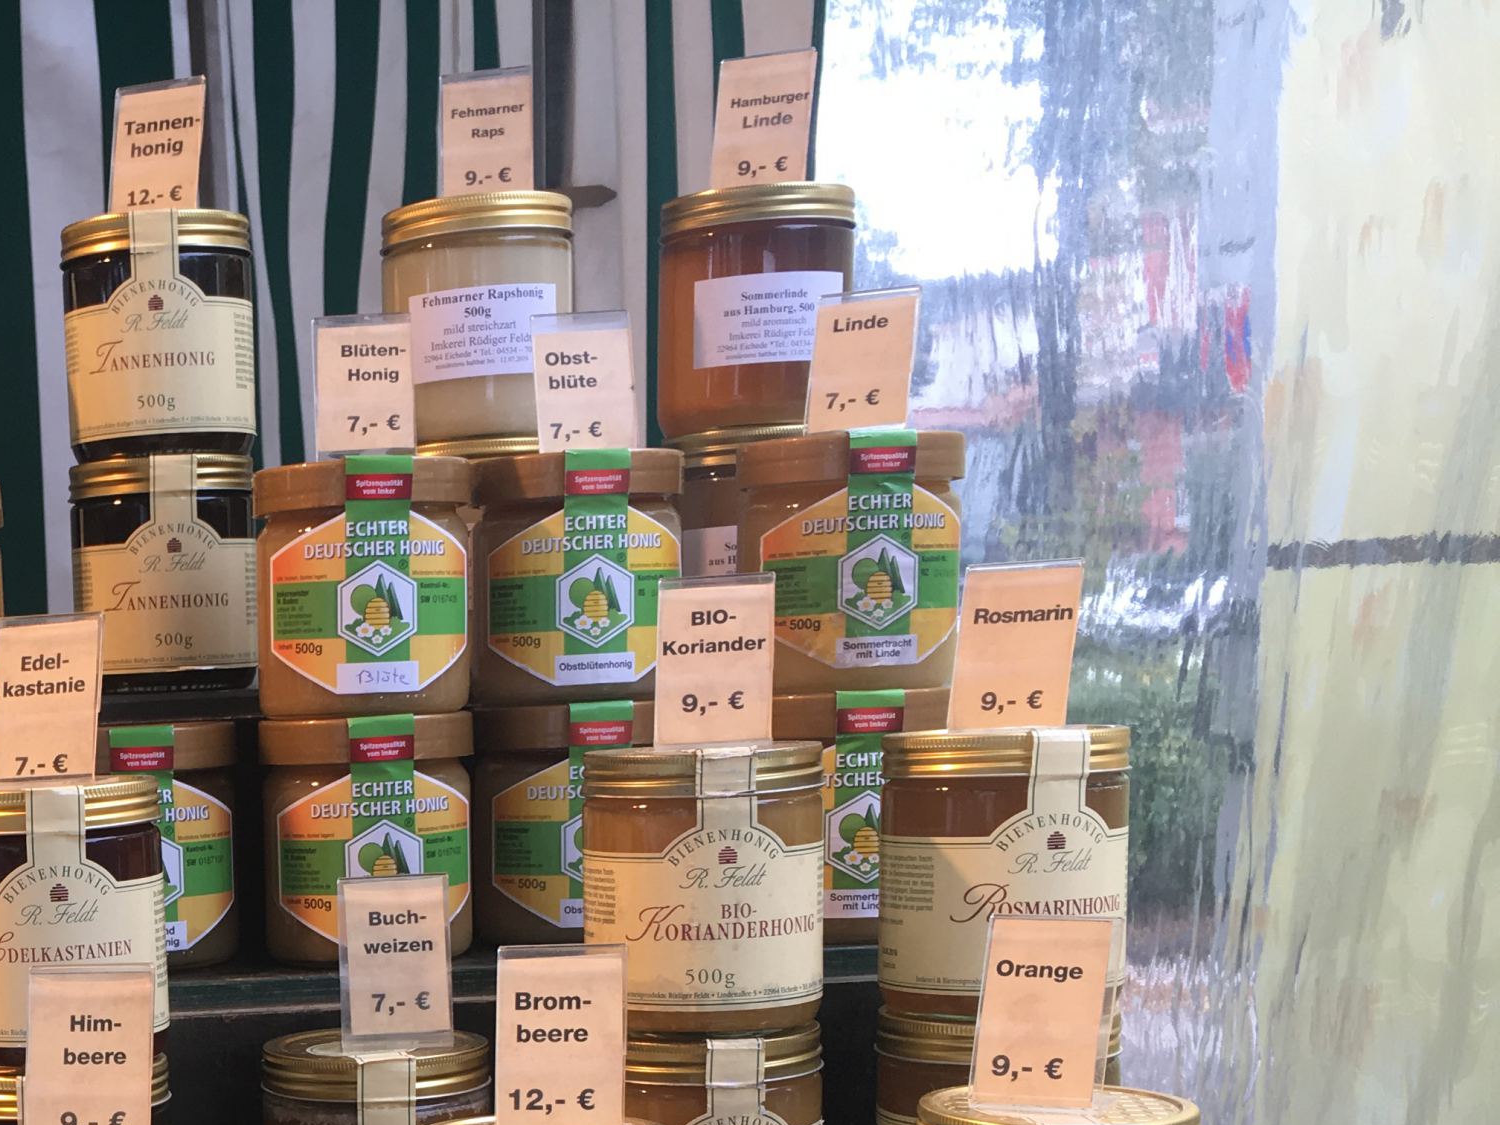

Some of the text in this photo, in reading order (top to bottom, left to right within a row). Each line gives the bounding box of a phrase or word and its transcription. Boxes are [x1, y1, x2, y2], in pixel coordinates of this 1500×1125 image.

[730, 91, 810, 109] Hamburger
[451, 101, 524, 120] Fehmarner
[124, 115, 200, 136] Tannen-
[742, 112, 793, 129] Linde
[471, 125, 505, 140] Raps
[130, 139, 184, 159] honig
[465, 167, 512, 186] 9.- €
[737, 156, 788, 178] 9,- €
[127, 185, 182, 207] 12.- €
[422, 286, 544, 309] Fehmarner Rapshonig
[464, 306, 491, 320] 500g
[833, 315, 889, 333] Linde
[89, 340, 216, 375] TANNENHONIG
[341, 344, 406, 358] Blüten-
[545, 352, 598, 367] Obst-
[348, 367, 400, 383] Honig
[549, 375, 598, 390] blüte
[825, 389, 880, 412] 7,- €
[347, 414, 401, 435] 7,- €
[550, 421, 602, 442] 7,- €
[690, 610, 736, 626] BIO-
[974, 605, 1073, 625] Rosmarin
[662, 636, 765, 655] Koriander
[843, 639, 912, 649] Sommertracht
[856, 648, 900, 658] mit Linde
[20, 654, 68, 672] Edel-
[559, 660, 632, 672] Obstblütenhonig
[2, 678, 85, 697] kastanie
[682, 691, 744, 717] 9,- €
[981, 690, 1043, 714] 9,- €
[15, 754, 68, 776] 7.- €
[369, 911, 427, 926] Buch-
[721, 902, 756, 919] BIO-
[363, 938, 433, 953] weizen
[996, 959, 1083, 982] Orange
[371, 991, 430, 1015] 7,- €
[514, 992, 592, 1010] Brom-
[69, 1014, 122, 1033] Him-
[516, 1025, 588, 1043] beere
[63, 1048, 126, 1065] beere
[991, 1055, 1063, 1081] 9,- €
[509, 1088, 595, 1114] 12,- €
